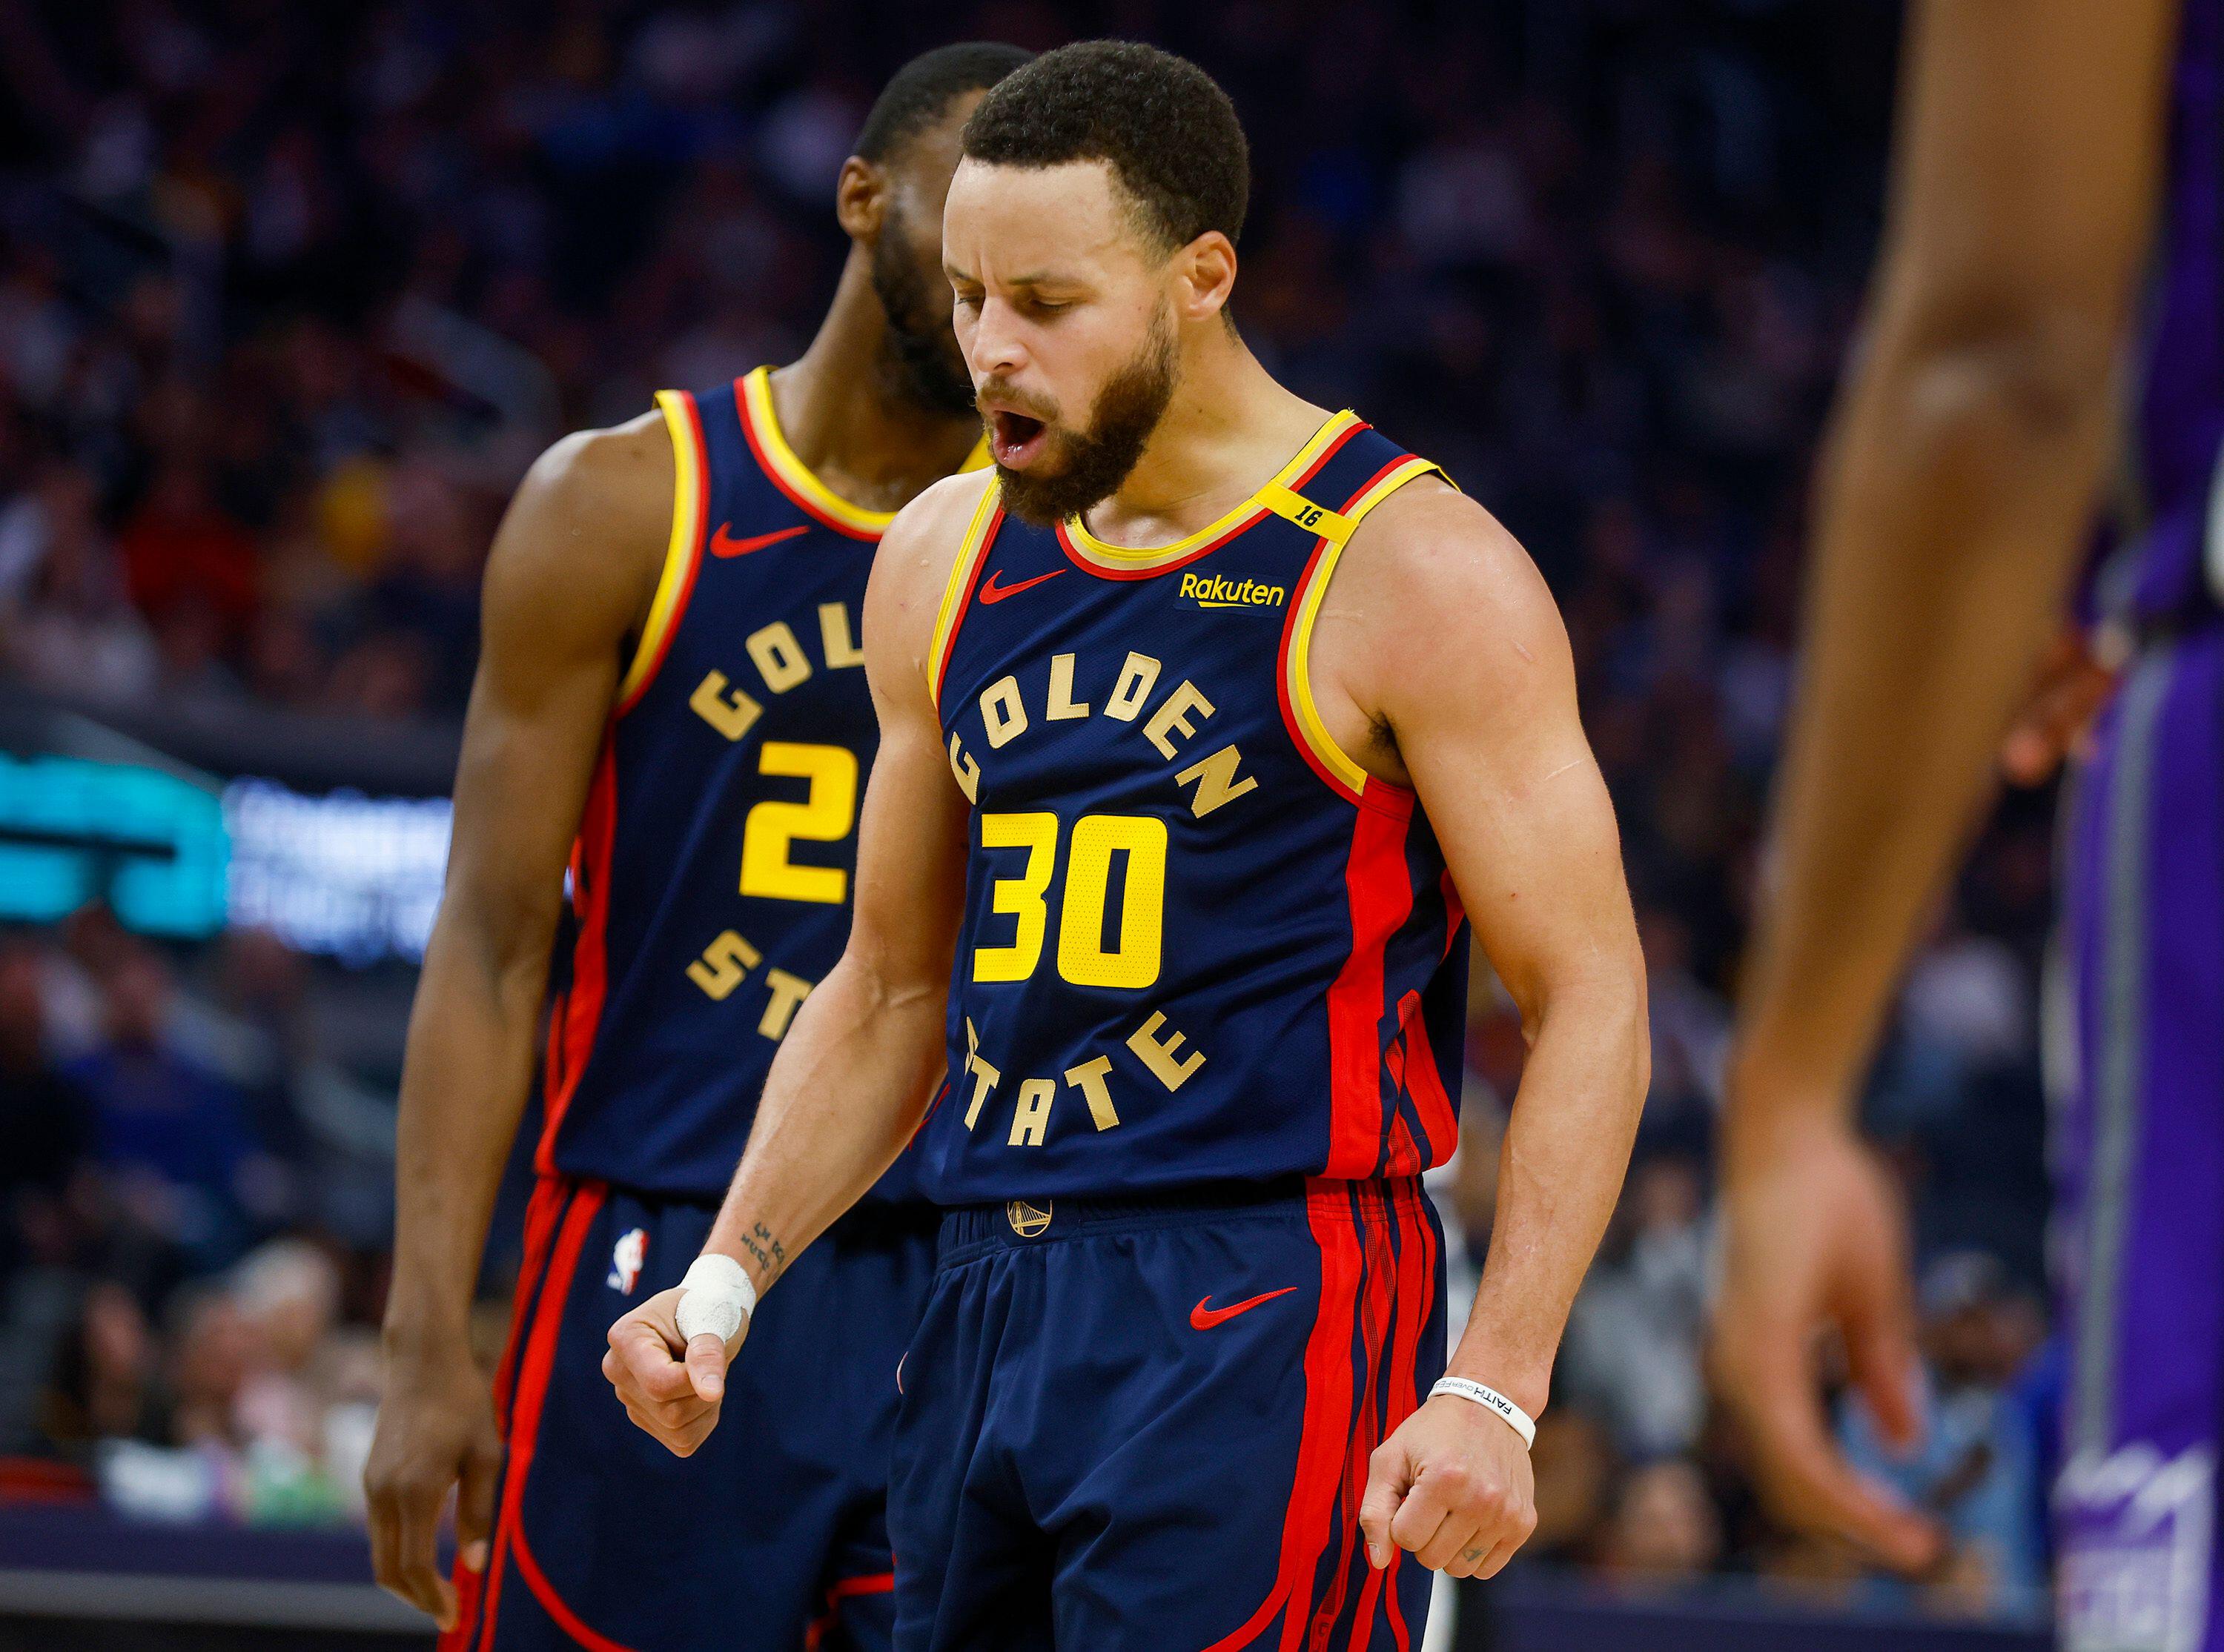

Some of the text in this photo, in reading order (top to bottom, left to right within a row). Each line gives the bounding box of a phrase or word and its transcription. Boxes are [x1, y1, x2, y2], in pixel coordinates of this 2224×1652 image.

[1294, 505, 1323, 527] 16
[1179, 573, 1285, 607] Rakuten
[950, 651, 1259, 818] GOLDEN
[738, 741, 859, 904] 2
[972, 812, 1168, 989] 30
[1452, 1382, 1474, 1391] OVER
[1474, 1387, 1512, 1415] FAITH
